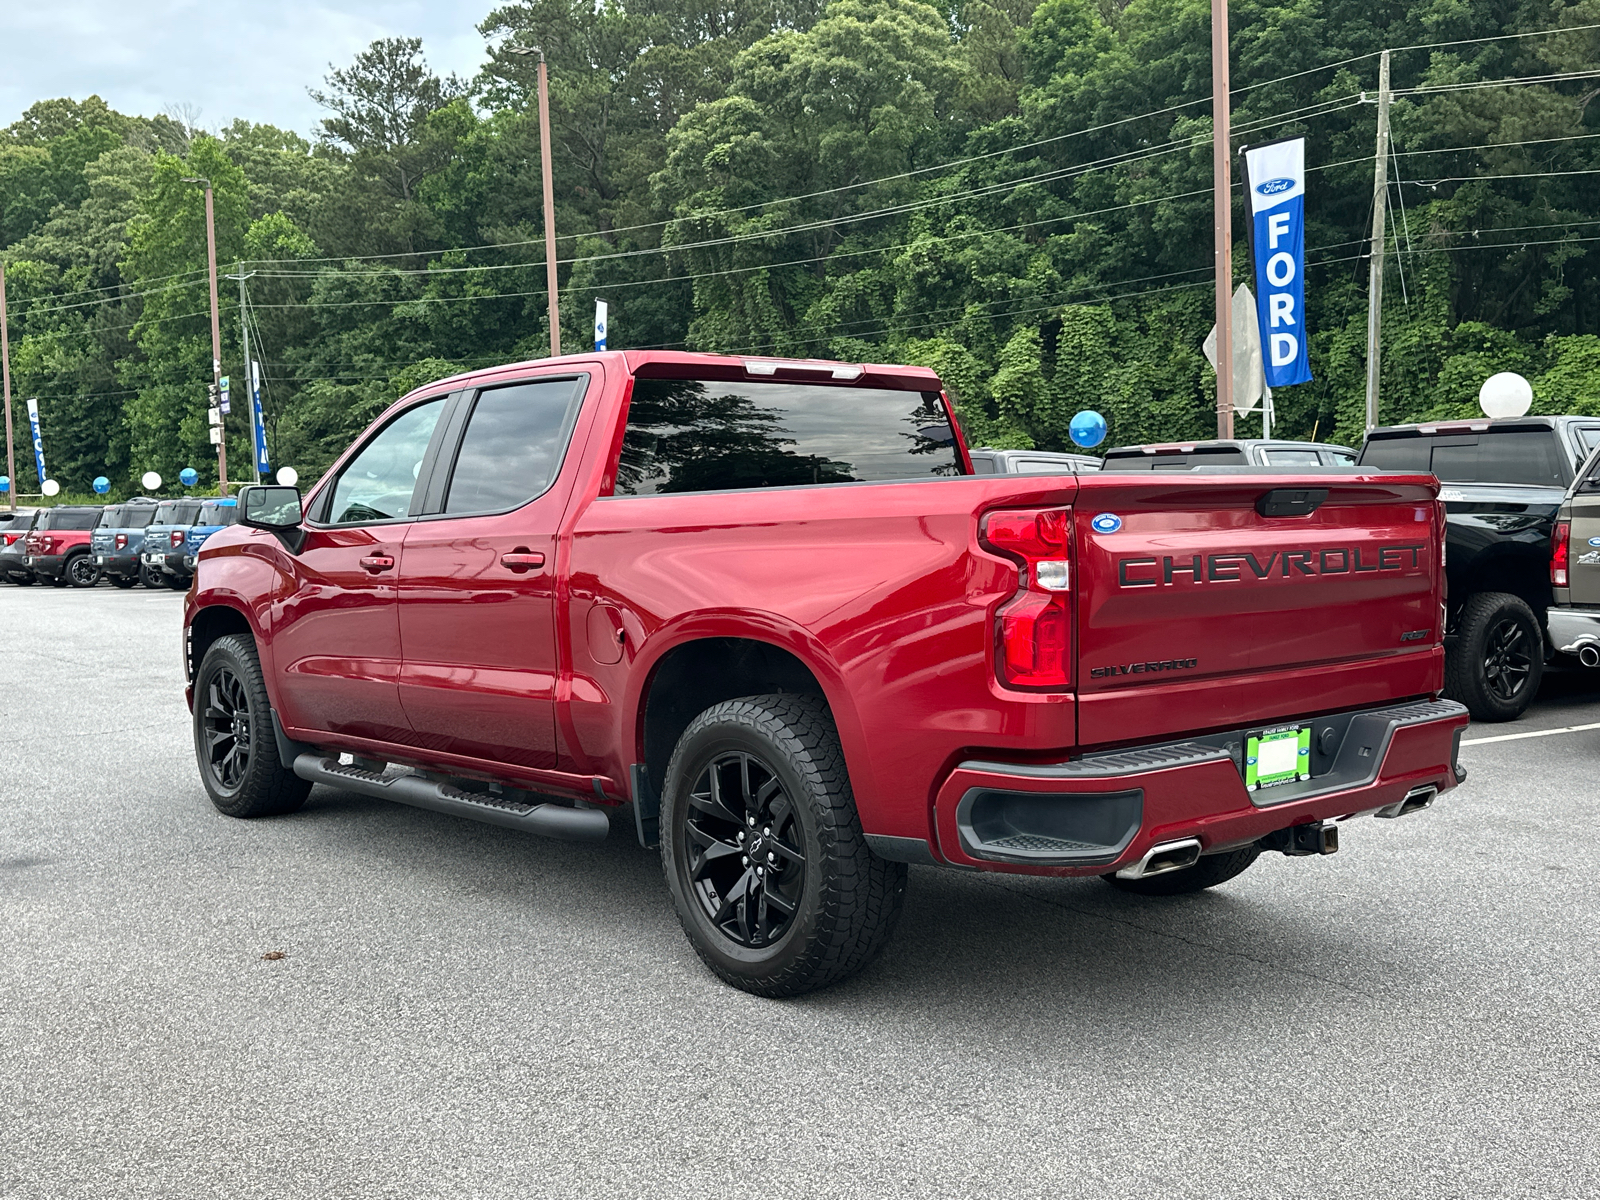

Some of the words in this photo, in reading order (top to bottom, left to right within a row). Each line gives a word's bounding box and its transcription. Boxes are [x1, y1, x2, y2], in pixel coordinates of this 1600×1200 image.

[1262, 180, 1289, 194] Ford
[1266, 212, 1298, 367] FORD
[1119, 544, 1426, 589] CHEVROLET
[1400, 629, 1431, 641] RST
[1091, 658, 1197, 678] SILVERADO
